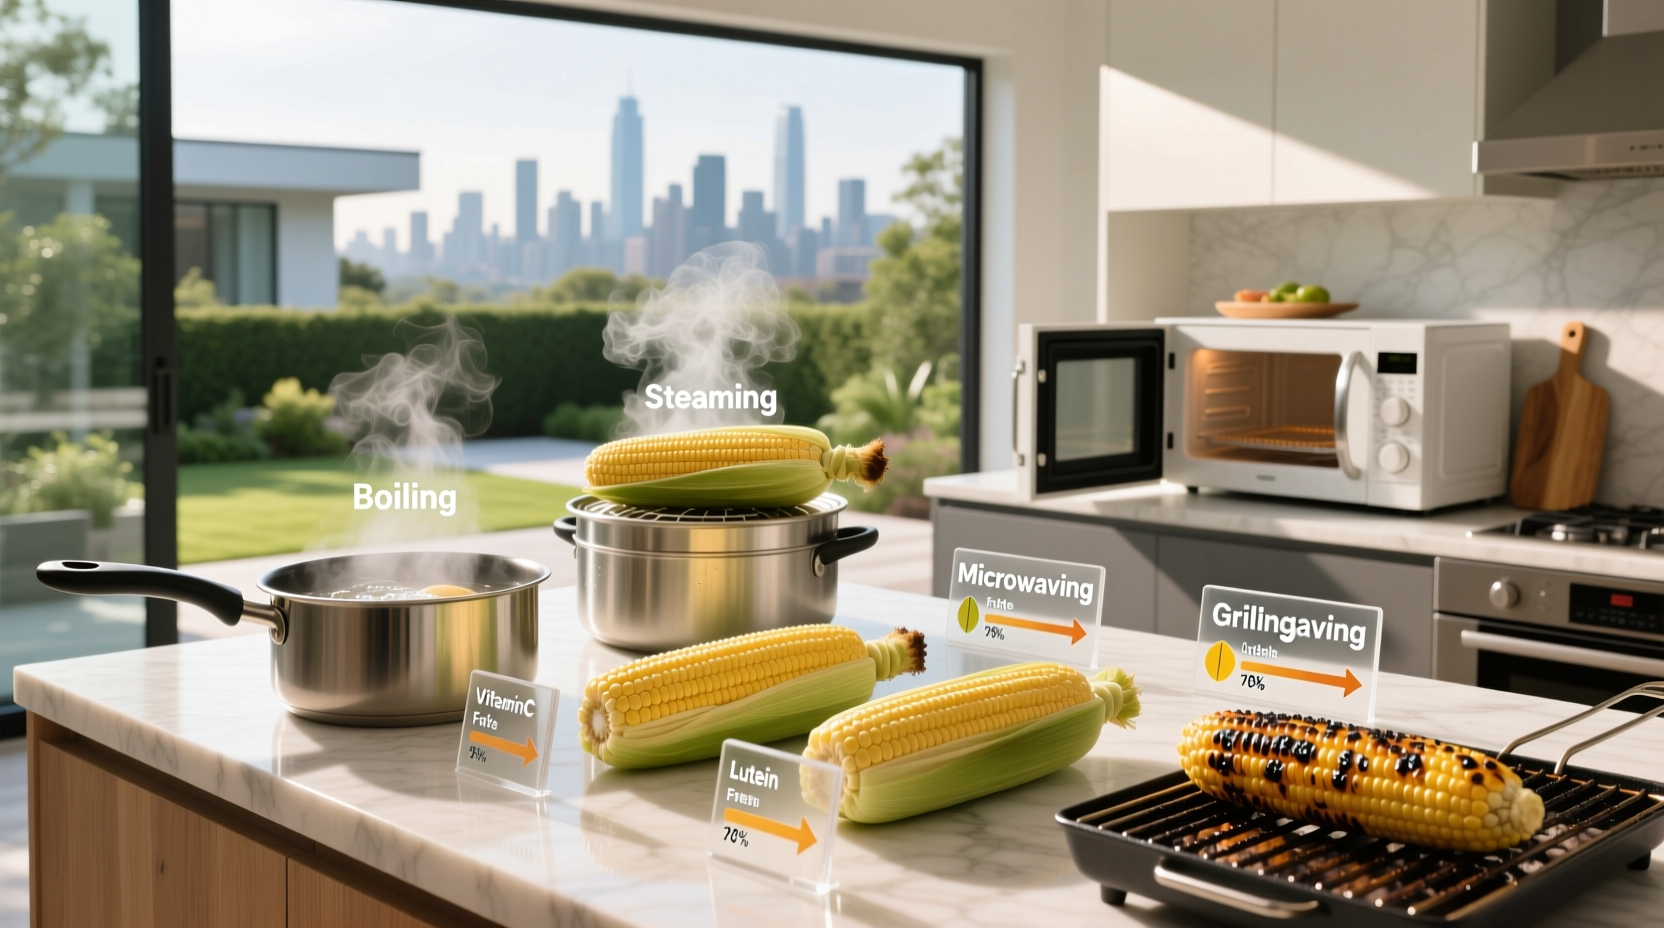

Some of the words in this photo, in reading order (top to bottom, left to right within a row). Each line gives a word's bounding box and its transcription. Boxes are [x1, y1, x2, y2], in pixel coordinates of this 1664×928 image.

[957, 562, 1094, 606] Microwaving
[1212, 602, 1367, 651] Grilingaving
[729, 760, 779, 790] Lutein
